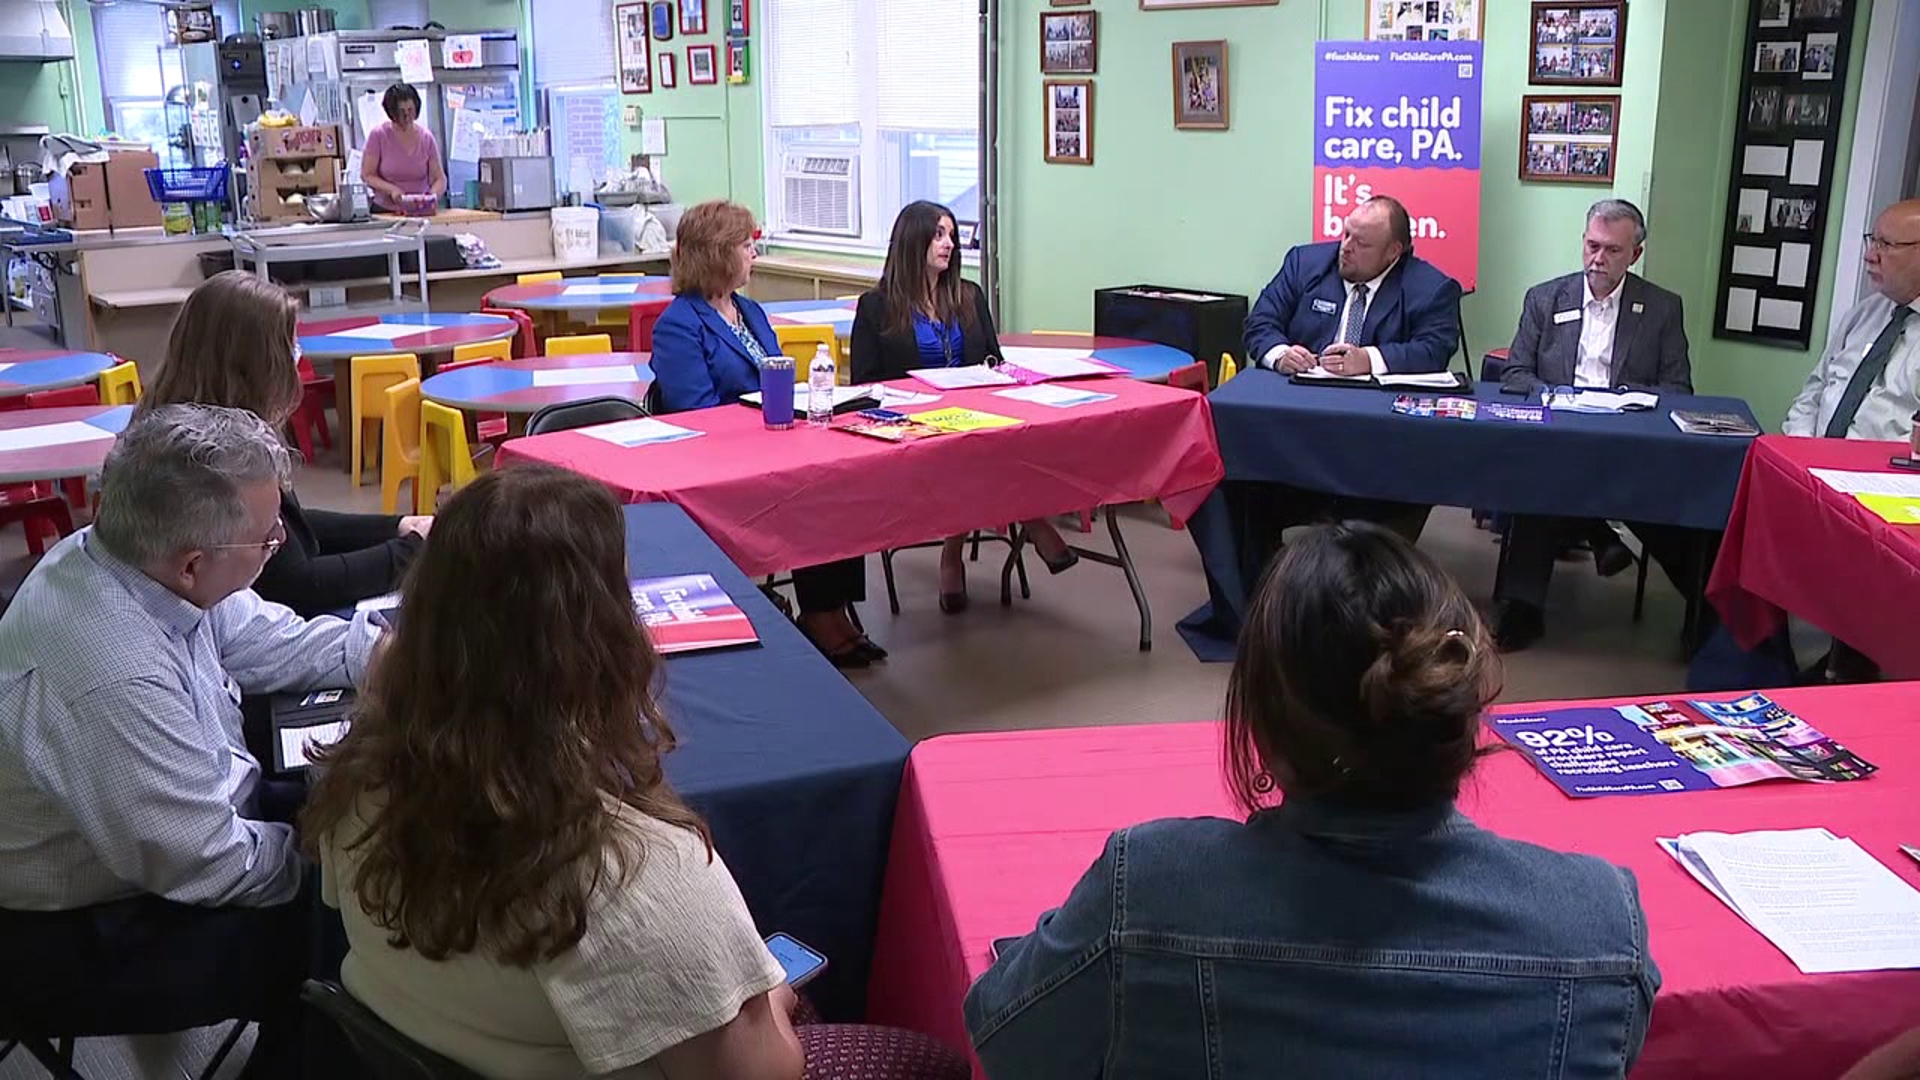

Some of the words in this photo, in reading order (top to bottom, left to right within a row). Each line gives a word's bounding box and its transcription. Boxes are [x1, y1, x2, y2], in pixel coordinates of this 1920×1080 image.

[1325, 52, 1380, 61] #fixchildcare
[1390, 52, 1473, 61] FixChildCarePA.com
[1325, 96, 1374, 128] Fix
[1381, 96, 1461, 128] child
[1324, 137, 1403, 164] care,
[1412, 128, 1463, 160] PA.
[1324, 174, 1372, 206] It's
[1516, 725, 1615, 748] 92%
[1603, 743, 1633, 752] care
[1606, 747, 1649, 758] report
[1557, 765, 1624, 775] recruiting
[1619, 760, 1679, 772] teachers
